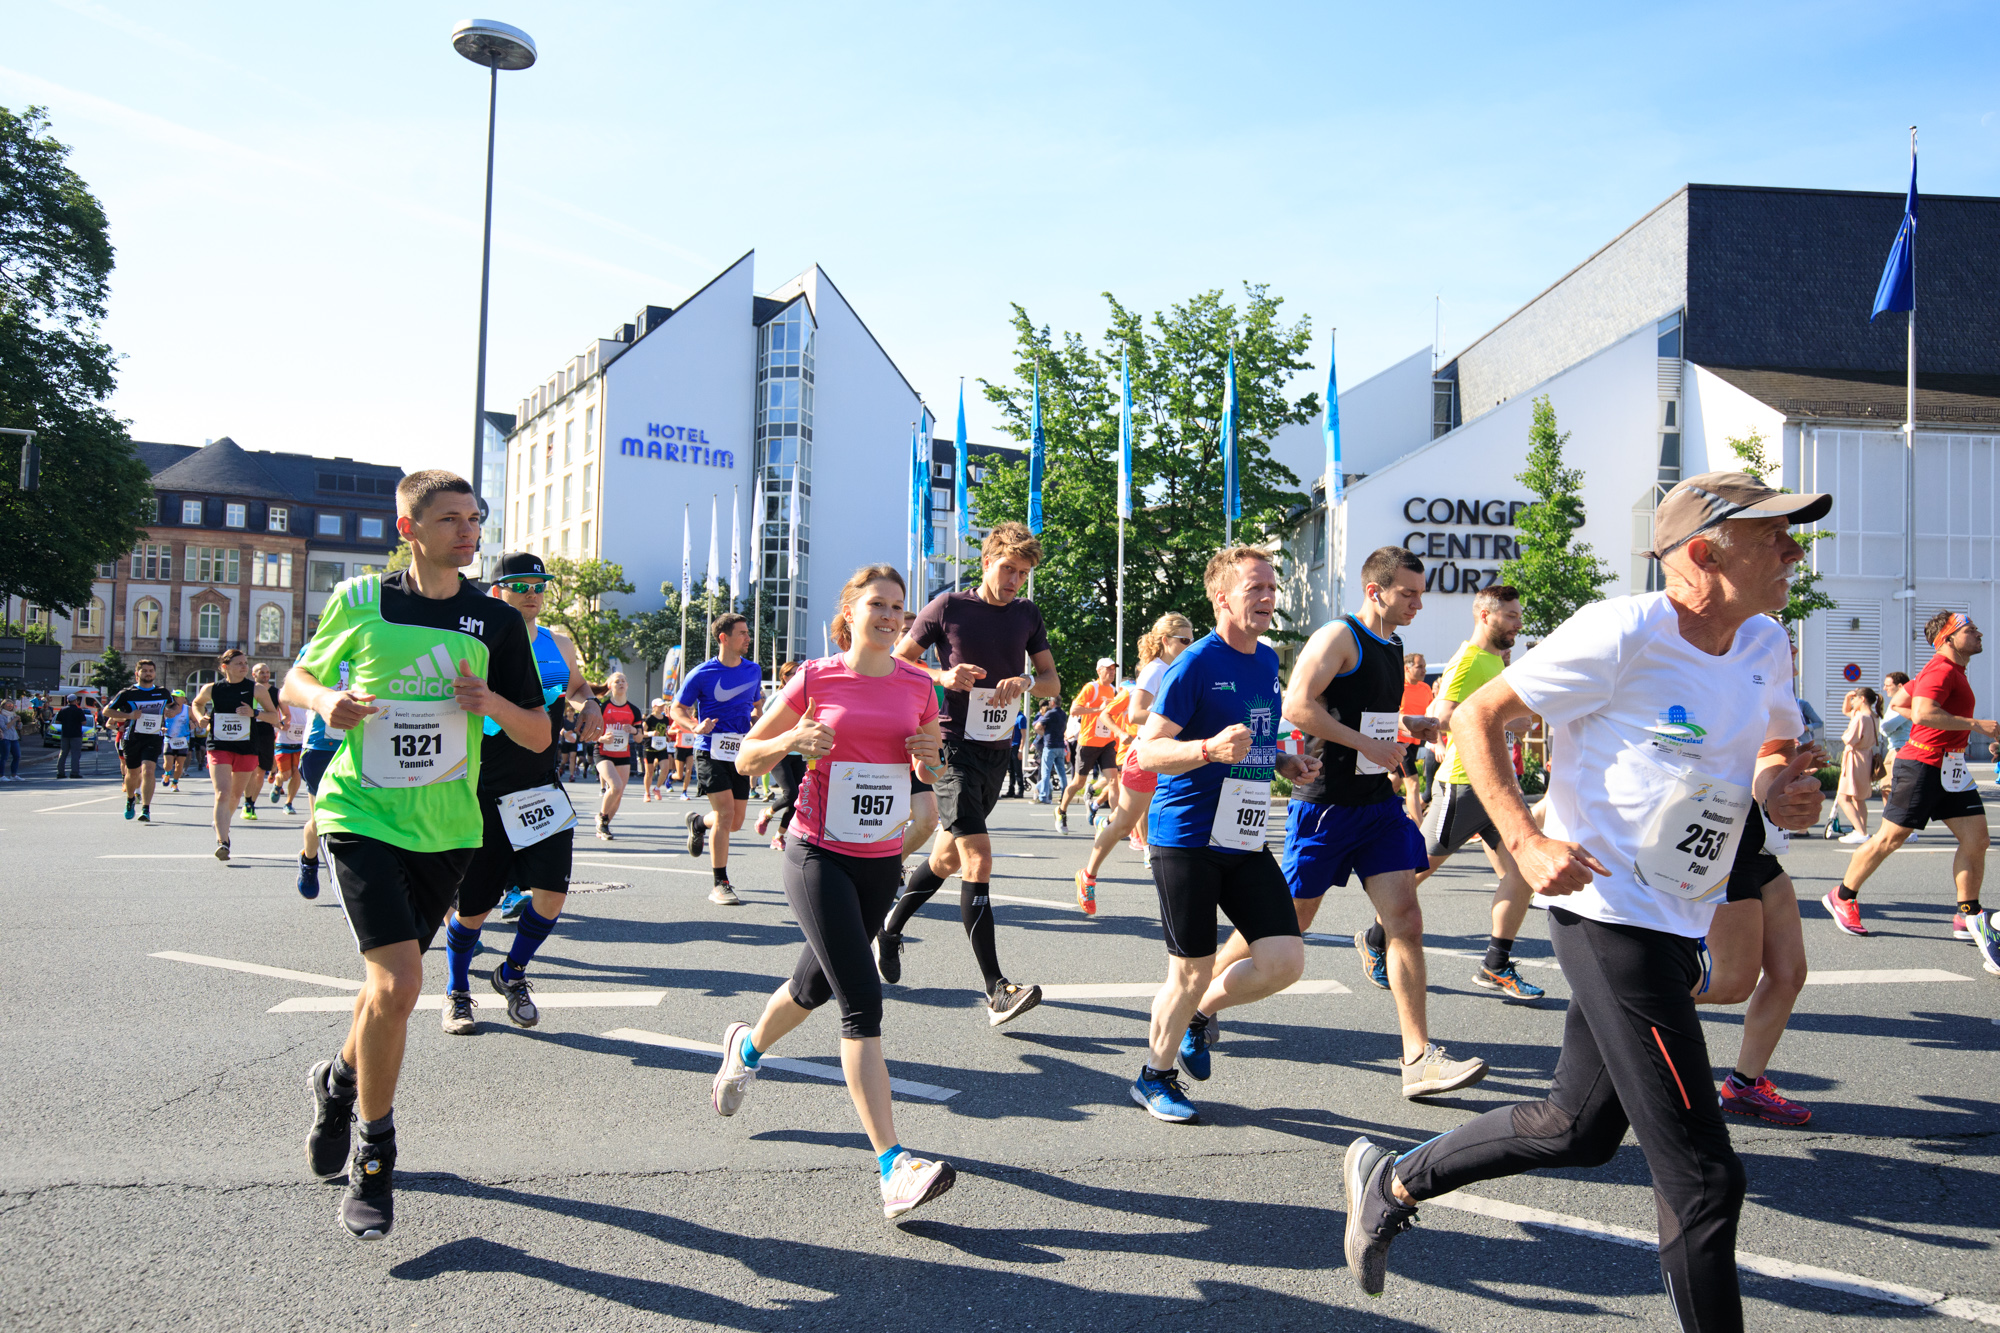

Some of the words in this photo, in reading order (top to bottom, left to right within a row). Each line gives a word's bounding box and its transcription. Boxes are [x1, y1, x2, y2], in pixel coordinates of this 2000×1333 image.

[648, 423, 710, 444] HOTEL
[621, 437, 734, 469] MARITIM
[388, 676, 456, 698] adida
[983, 709, 1008, 723] 1163
[222, 723, 242, 732] 2045
[394, 722, 440, 730] Halbmarathon
[390, 733, 442, 757] 1321
[719, 740, 741, 752] 2589
[399, 759, 434, 769] Yannick
[1230, 767, 1275, 779] FINISHE
[856, 783, 892, 791] Halbmarathon
[851, 794, 894, 816] 1957
[518, 804, 555, 828] 1526
[859, 818, 883, 826] Annika
[1236, 807, 1266, 827] 1972
[532, 820, 551, 831] Tobias
[1239, 828, 1259, 837] Roland
[1675, 823, 1730, 861] 253
[1688, 861, 1709, 876] Paul
